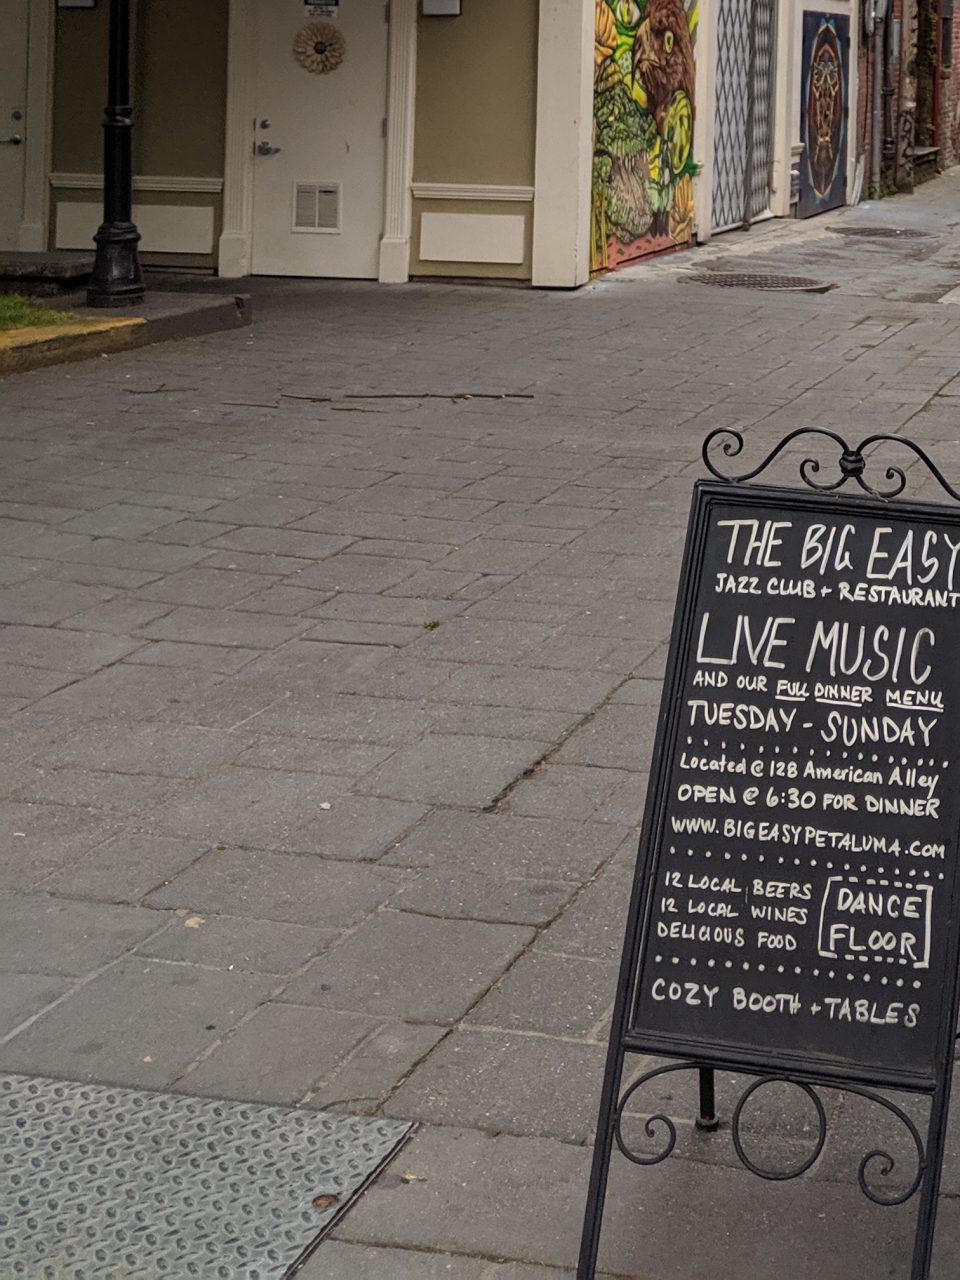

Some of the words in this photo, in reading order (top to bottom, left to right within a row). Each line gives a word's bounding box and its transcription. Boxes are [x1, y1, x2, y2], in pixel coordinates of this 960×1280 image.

[717, 519, 792, 567] THE
[801, 524, 855, 575] BIG
[715, 573, 761, 594] JAZZ
[767, 577, 816, 598] CLUB
[696, 612, 795, 669] LIVE
[805, 621, 935, 685] MUSIC
[693, 670, 728, 687] AND
[737, 675, 767, 691] OUR
[775, 680, 809, 698] FULL
[814, 682, 873, 704] DINNER
[886, 689, 944, 708] MENU
[688, 699, 798, 732] TUESDAY
[821, 709, 938, 746] SUNDAY
[680, 752, 746, 774] Located
[751, 760, 763, 777] @
[770, 760, 798, 778] 128
[803, 760, 883, 784] American
[887, 768, 939, 800] Alley
[678, 784, 736, 803] OPEN
[743, 787, 759, 805] @
[766, 787, 816, 809] 6:30
[823, 794, 858, 810] FOR
[865, 794, 940, 819] DINNER
[665, 871, 683, 887] 12
[688, 874, 742, 893] LOCAL
[753, 879, 812, 899] BEERS
[837, 886, 923, 918] DANCE
[661, 897, 678, 913] 12
[688, 899, 738, 917] LOCAL
[751, 905, 808, 924] WINES
[658, 922, 744, 947] DELICIOUS
[758, 932, 796, 950] FOOD
[827, 924, 917, 961] FLOOR
[652, 978, 719, 1007] COZY
[733, 987, 801, 1014] BOOTH
